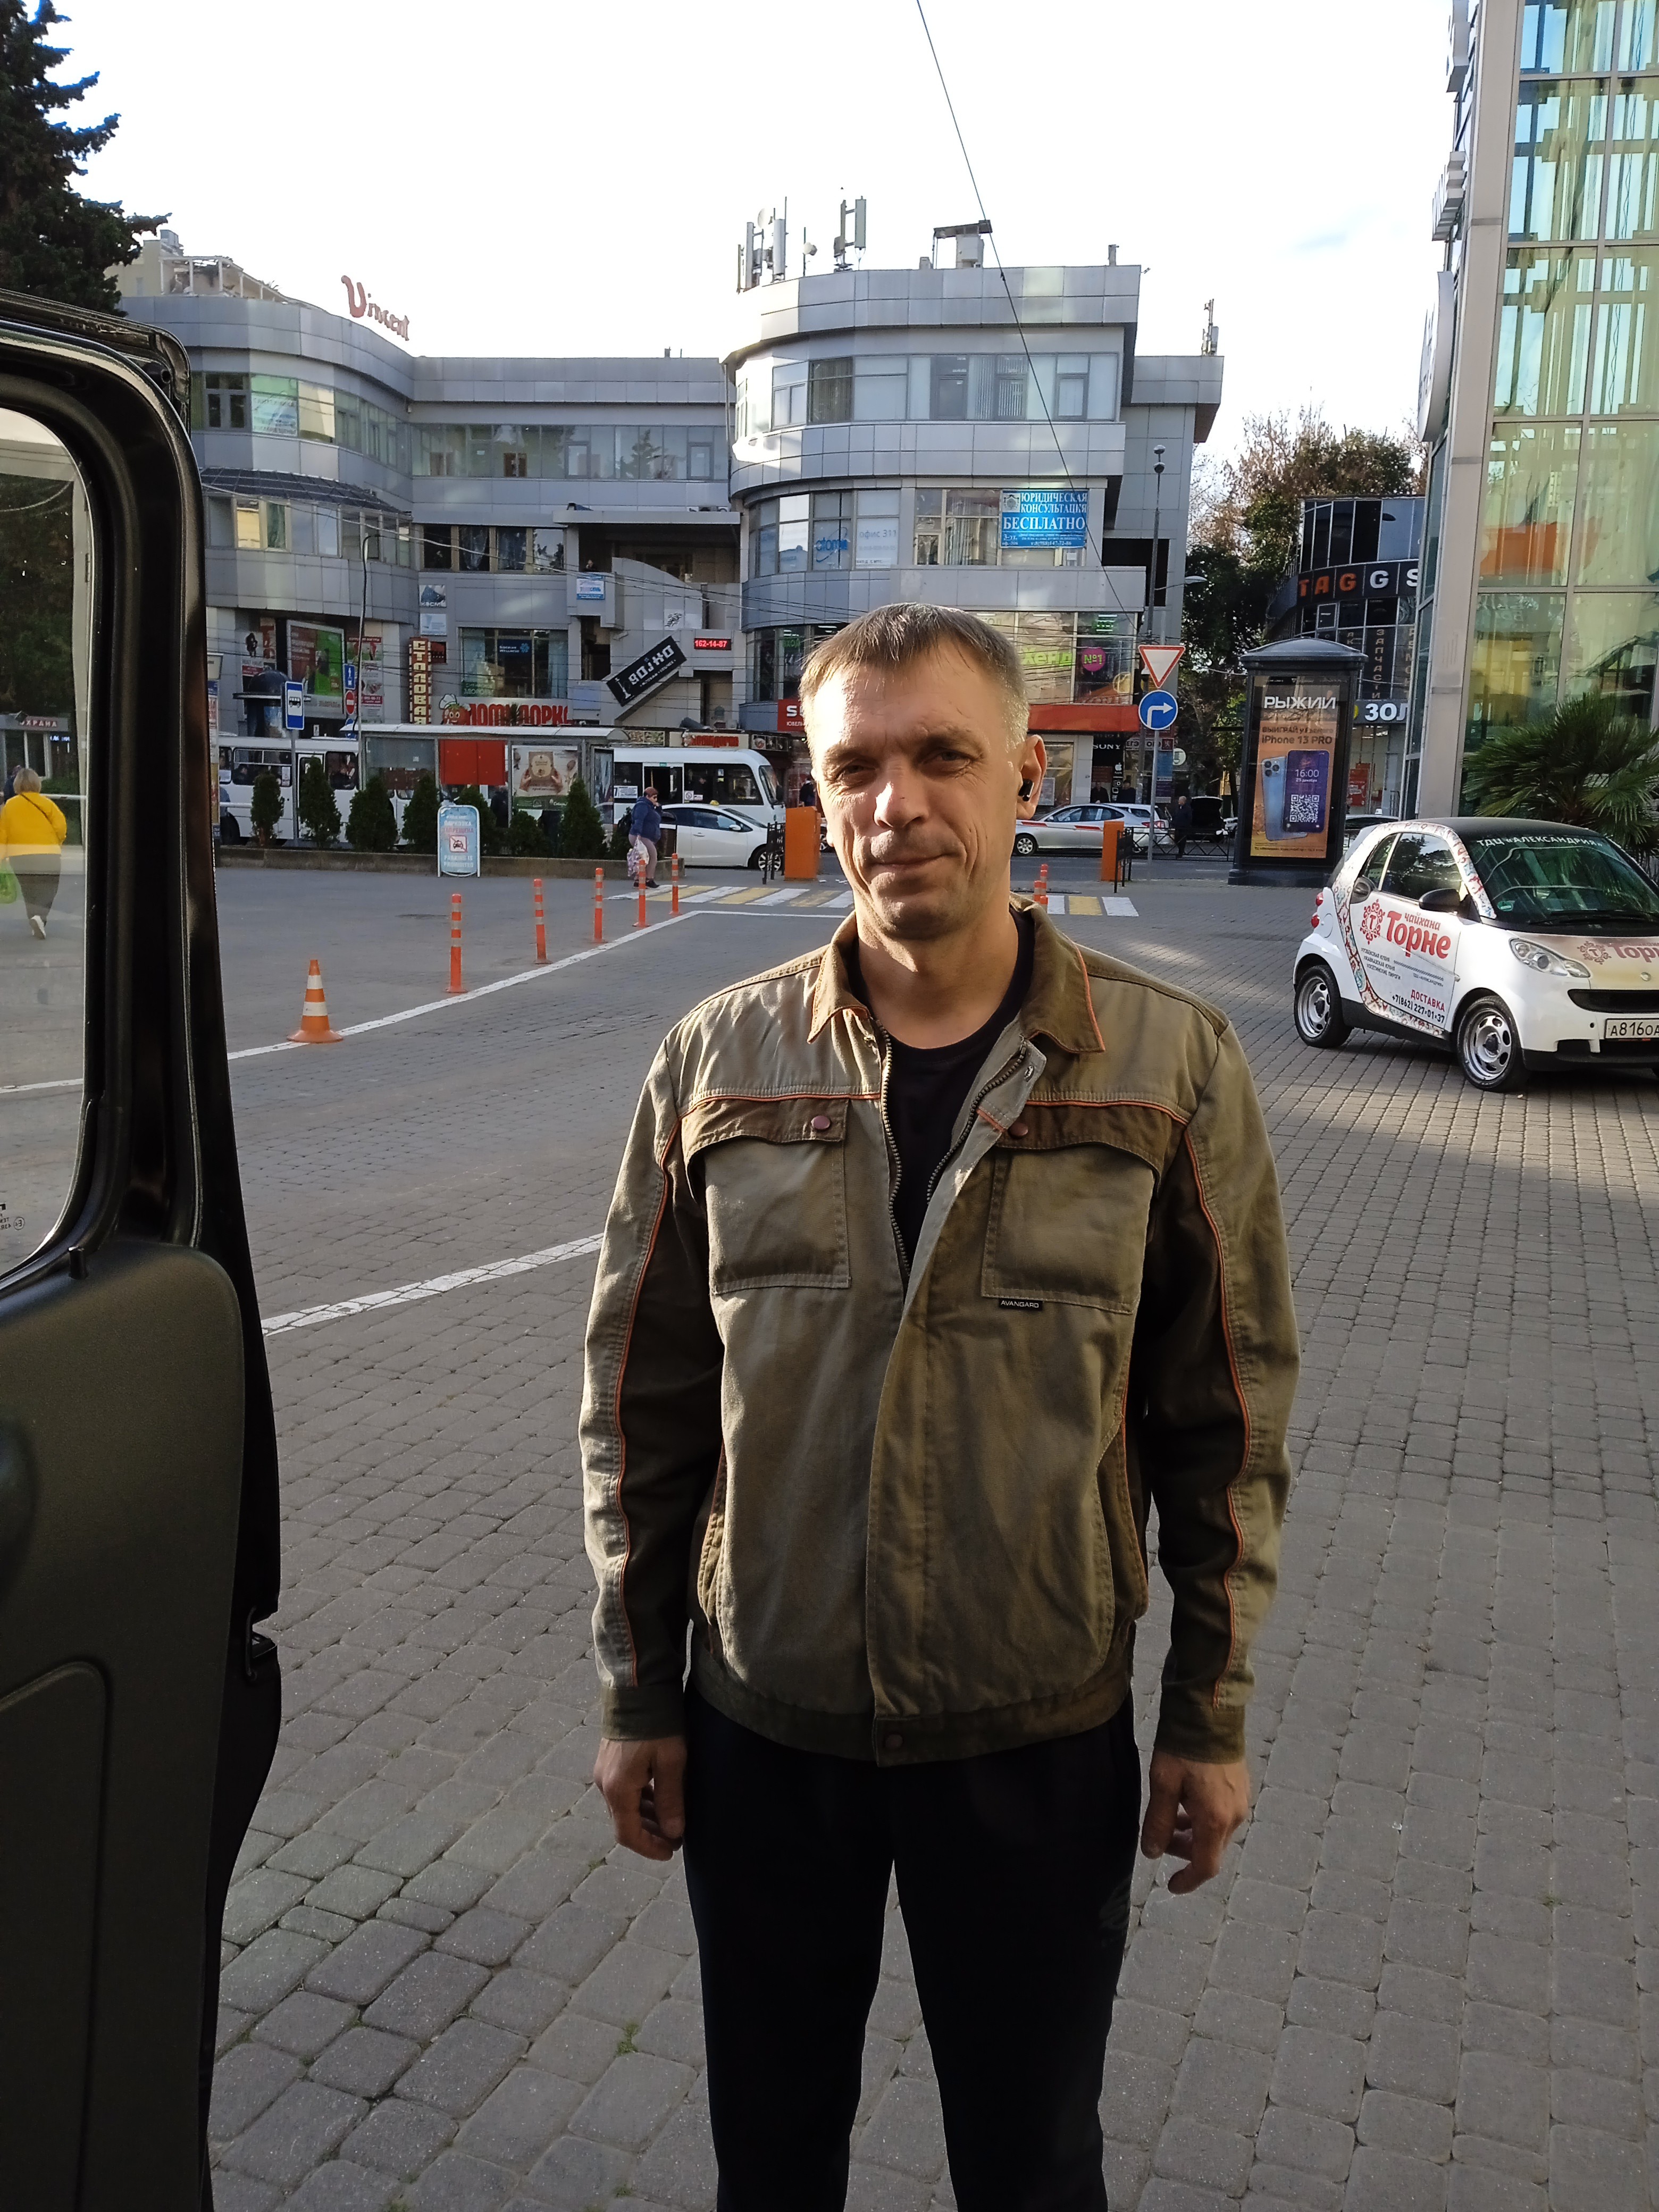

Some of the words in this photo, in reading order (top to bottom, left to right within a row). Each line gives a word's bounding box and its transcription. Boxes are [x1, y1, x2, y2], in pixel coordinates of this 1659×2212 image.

[1021, 492, 1087, 502] ЮРИДИЧЕСКАЯ
[1021, 504, 1087, 514] КОНСУЛЬТАЦИЯ
[1003, 517, 1086, 530] БЕСПЛАТНО
[859, 530, 880, 539] офис
[1084, 655, 1103, 665] №1
[1372, 629, 1384, 698] ЗАПЧАСТИ
[1262, 735, 1295, 744] iPhone
[1477, 837, 1505, 847] ТДЦ
[1506, 836, 1603, 847] «АЛЕКСАНДРИЯ»
[1404, 912, 1441, 931] чайхана
[1387, 911, 1451, 959] Торне
[1411, 989, 1445, 1012] ДОСТАВКА
